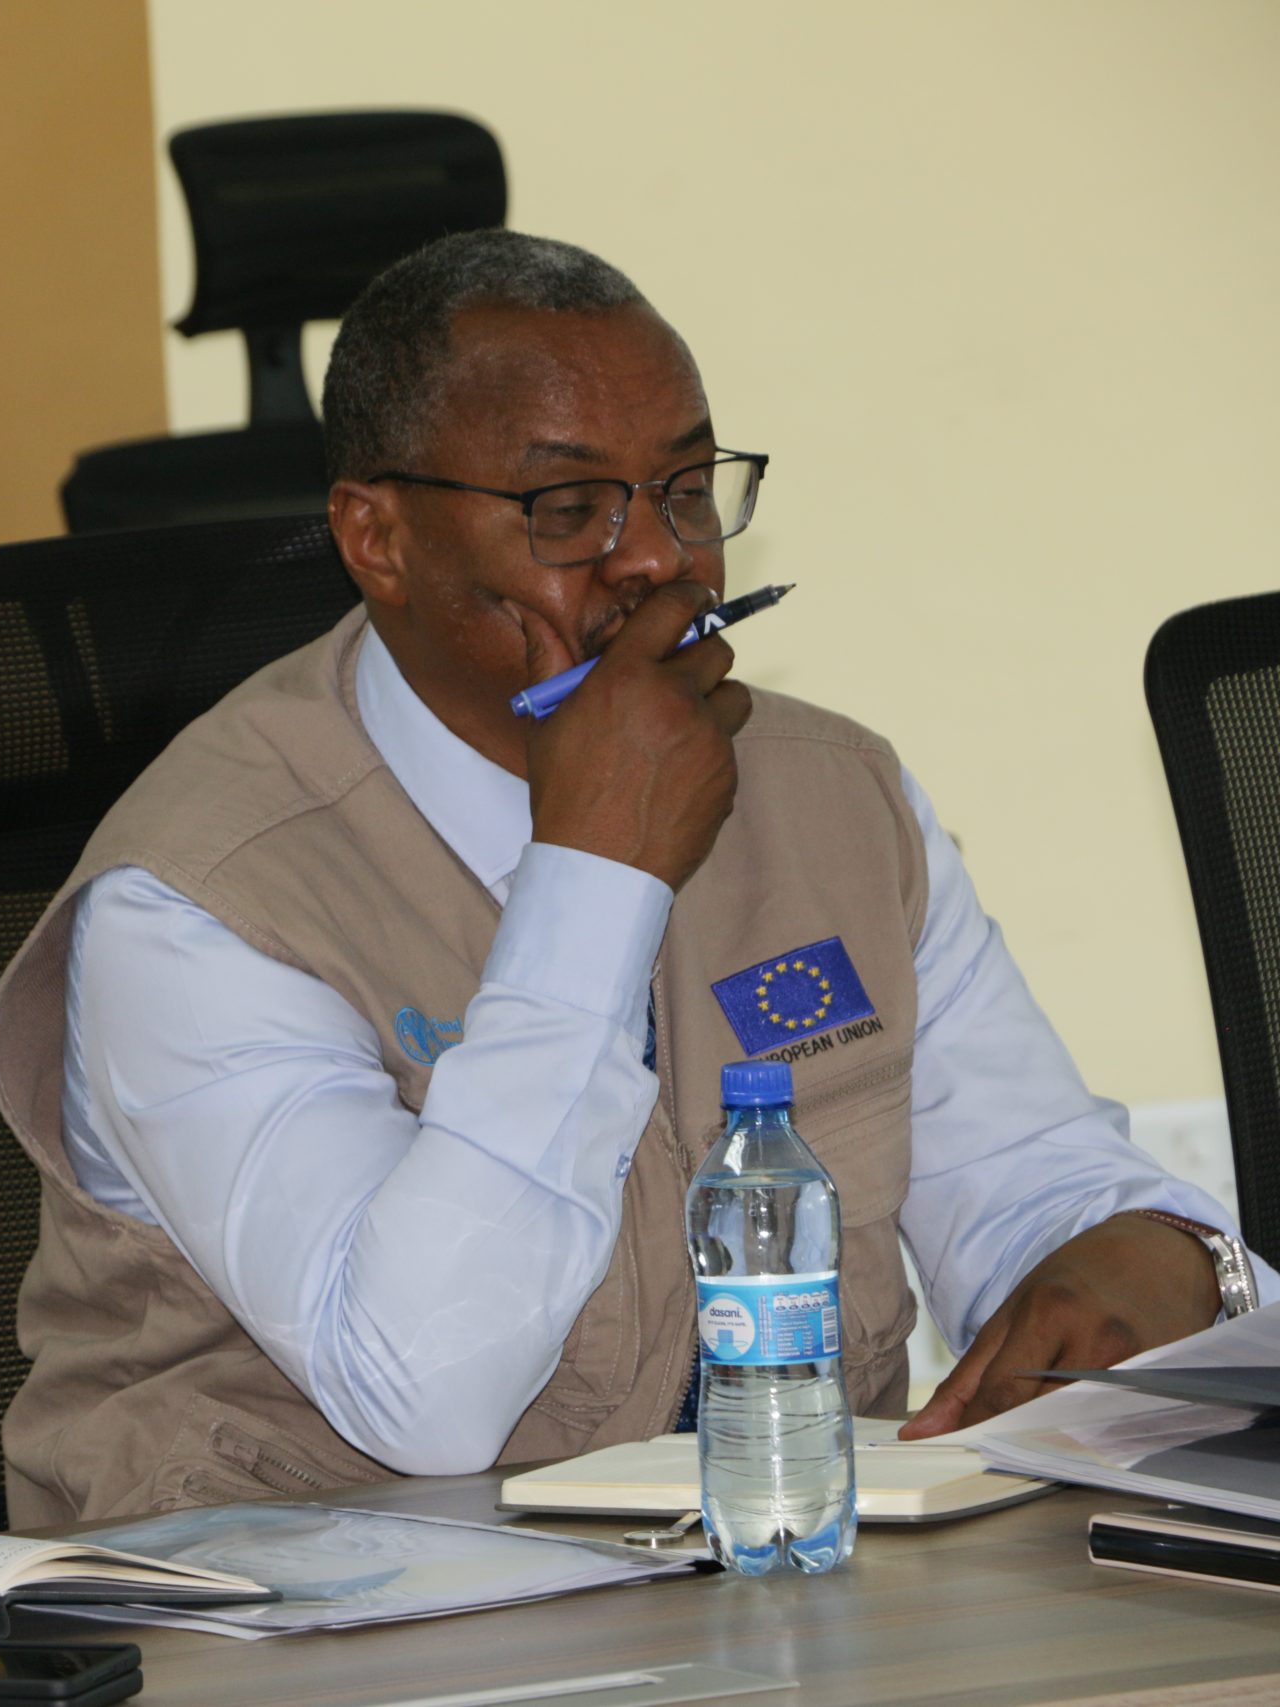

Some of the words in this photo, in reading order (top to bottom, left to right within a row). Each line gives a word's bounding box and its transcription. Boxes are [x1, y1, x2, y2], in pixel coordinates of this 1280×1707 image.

[758, 1033, 835, 1063] ROPEAN
[836, 1017, 884, 1044] UNION
[709, 1306, 740, 1318] dasani
